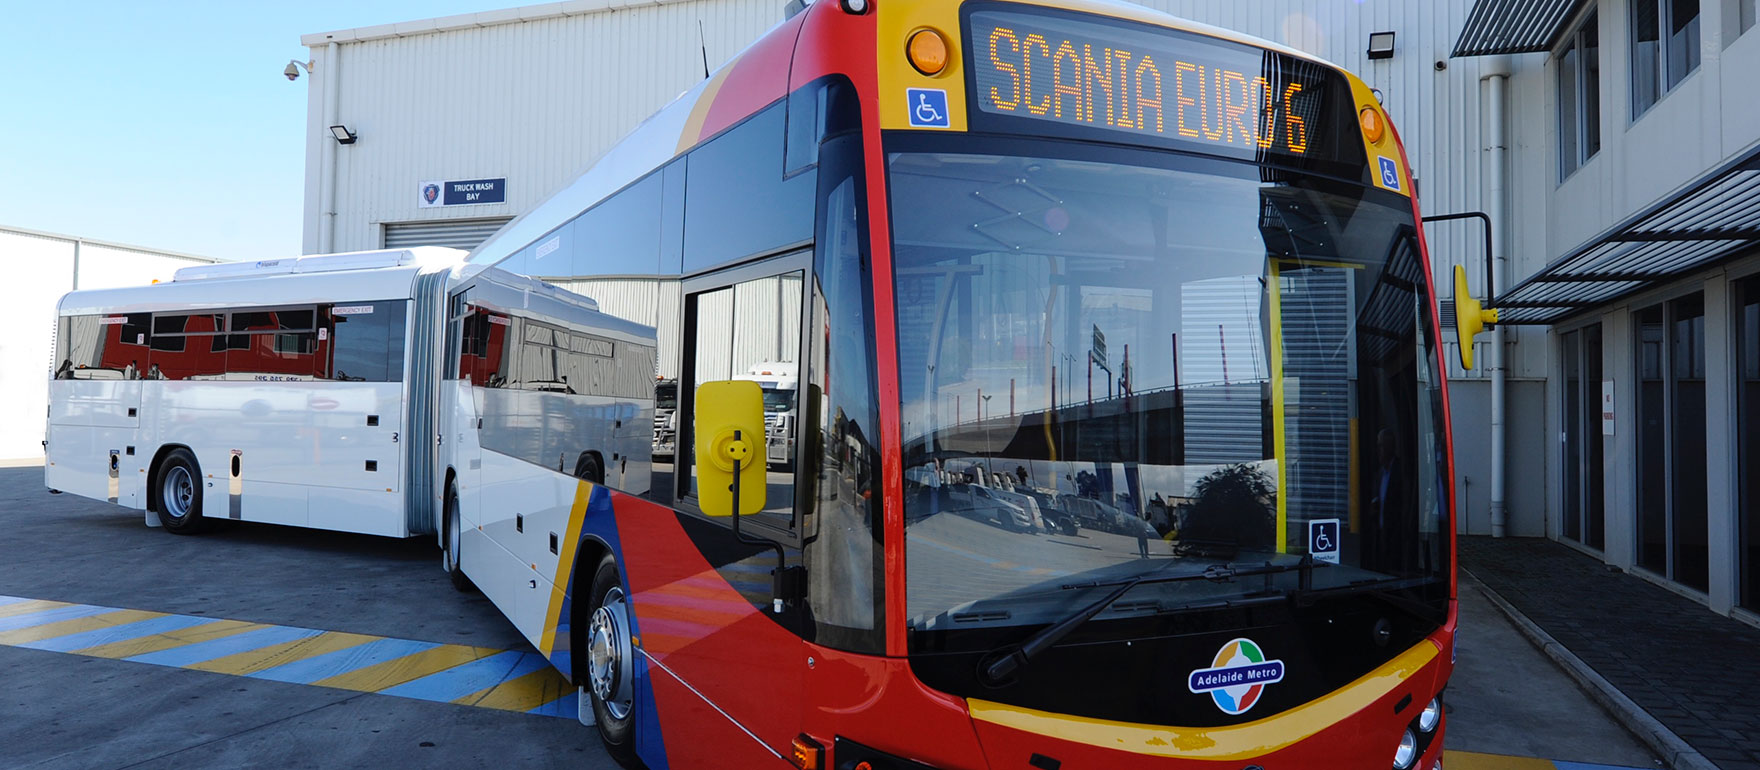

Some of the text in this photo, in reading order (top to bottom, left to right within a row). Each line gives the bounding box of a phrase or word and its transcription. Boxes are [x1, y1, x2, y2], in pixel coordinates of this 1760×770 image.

[990, 27, 1306, 153] SCANIA EURO 6
[454, 183, 494, 192] TRUCK WASH
[466, 193, 480, 201] BAY
[1197, 669, 1277, 686] Adelaide Metro
